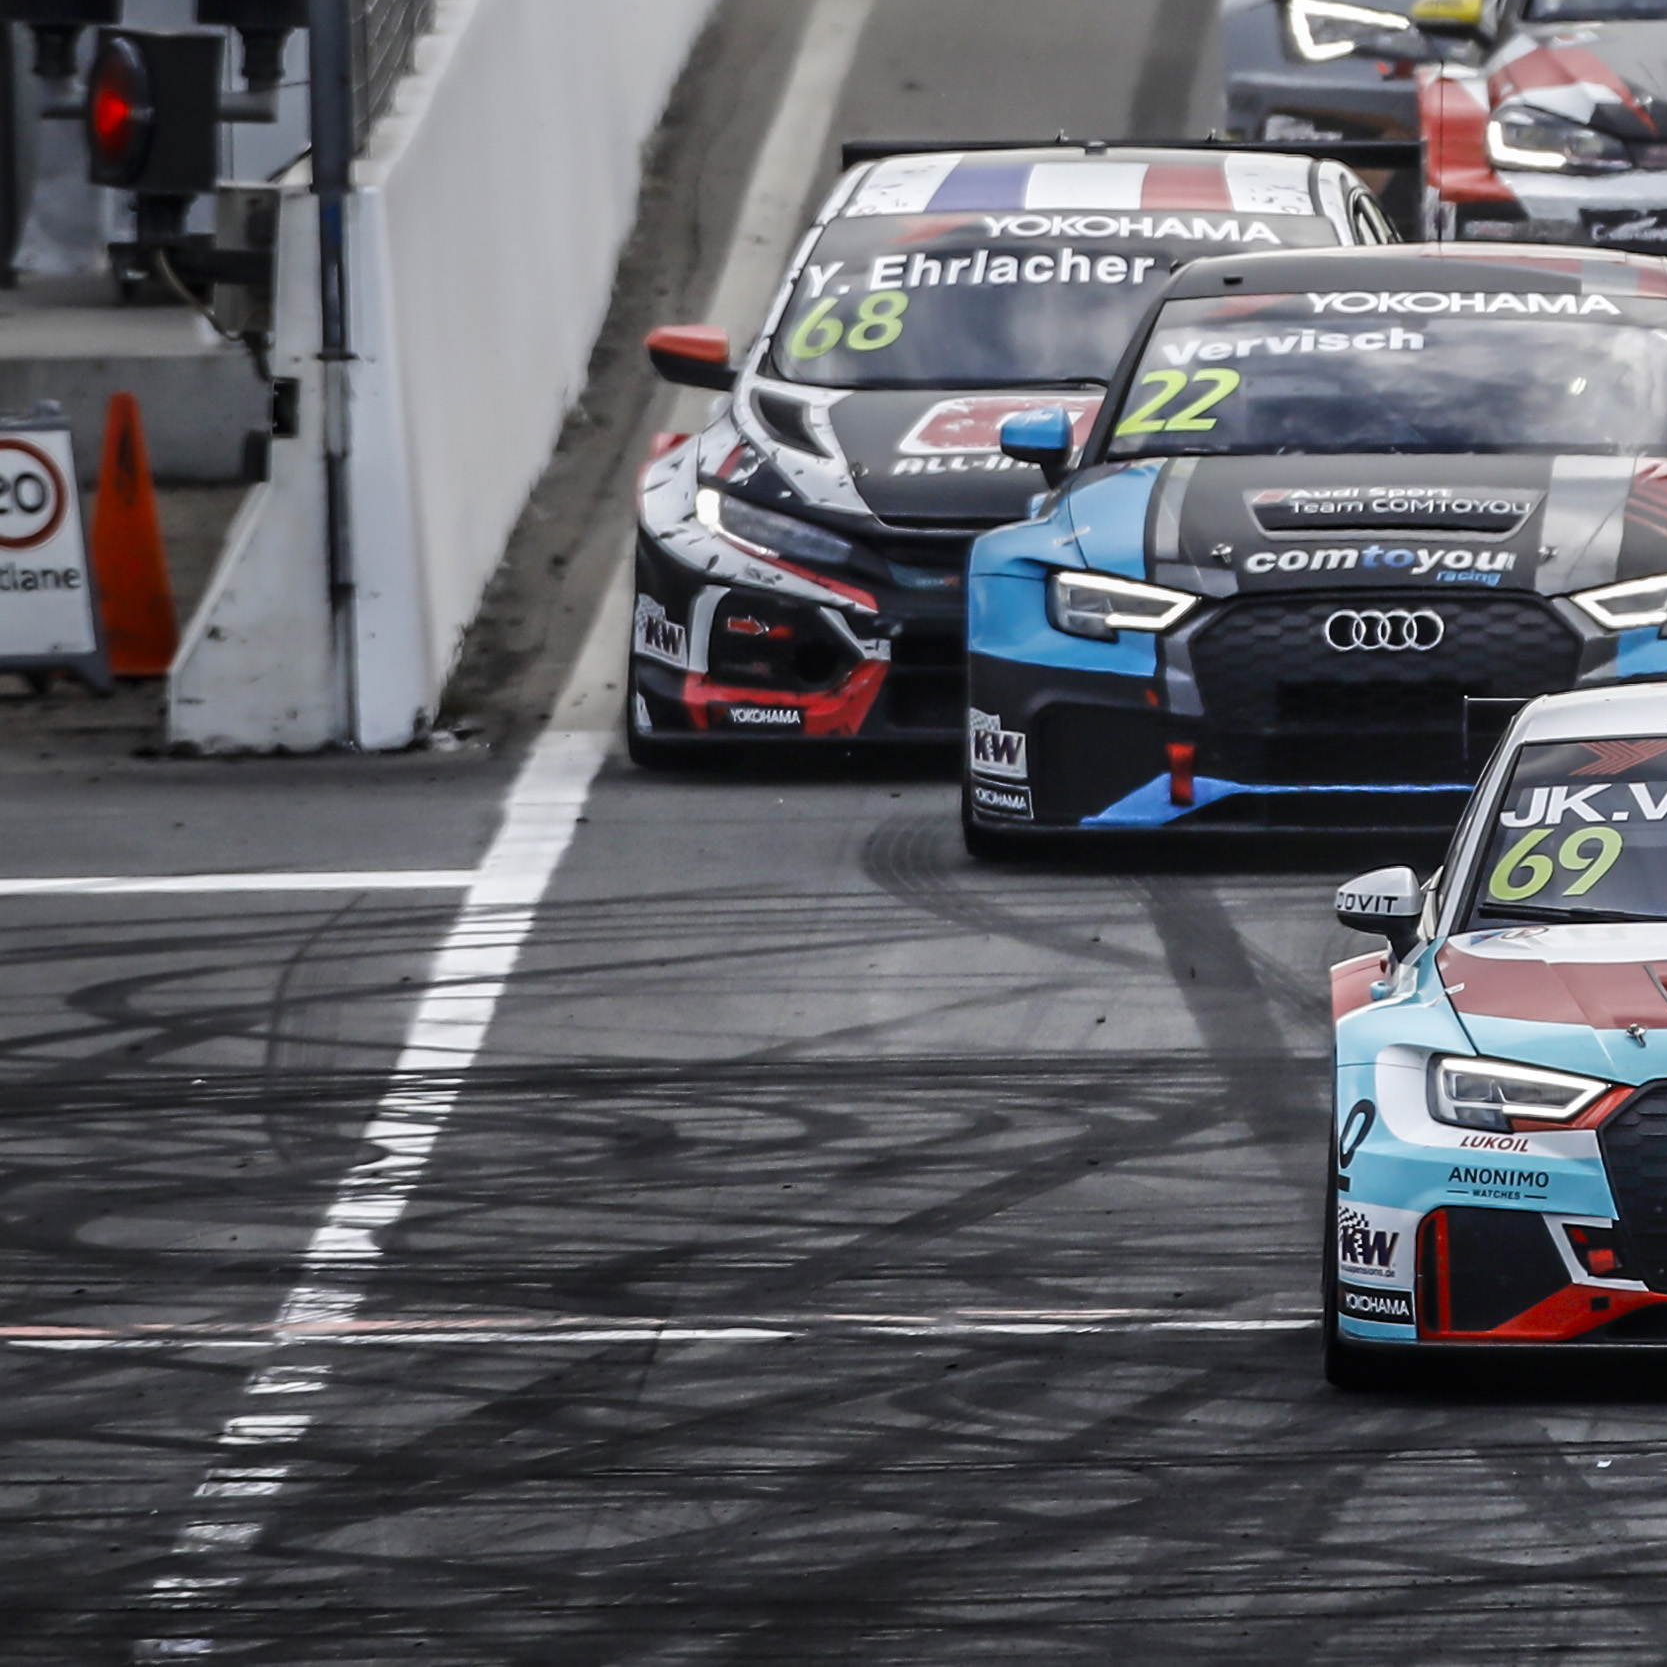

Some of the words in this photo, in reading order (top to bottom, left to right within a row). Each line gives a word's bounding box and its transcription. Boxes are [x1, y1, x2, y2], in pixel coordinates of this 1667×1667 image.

[984, 216, 1280, 244] YOKOHAMA
[807, 262, 850, 299] Y.
[870, 248, 1155, 290] Ehrlacher
[1307, 292, 1621, 315] YOKOHAMA
[790, 291, 910, 359] 68
[1163, 328, 1426, 365] Vervisch
[1115, 368, 1240, 437] 22
[1290, 487, 1358, 498] Audi
[1369, 487, 1452, 498] Sport
[1291, 499, 1363, 514] Team
[1372, 499, 1531, 514] COMTOYOU
[1246, 545, 1517, 576] comtoyou
[1436, 570, 1501, 586] racing
[730, 708, 801, 724] YOKOHAMA
[974, 729, 1023, 765] KW
[1489, 827, 1622, 901] 69
[1337, 891, 1398, 913] DOVIT
[1459, 1136, 1529, 1153] LUKOIL
[1448, 1167, 1549, 1188] ANONIMO
[1472, 1189, 1521, 1200] WATCHES
[1341, 1227, 1399, 1267] KW
